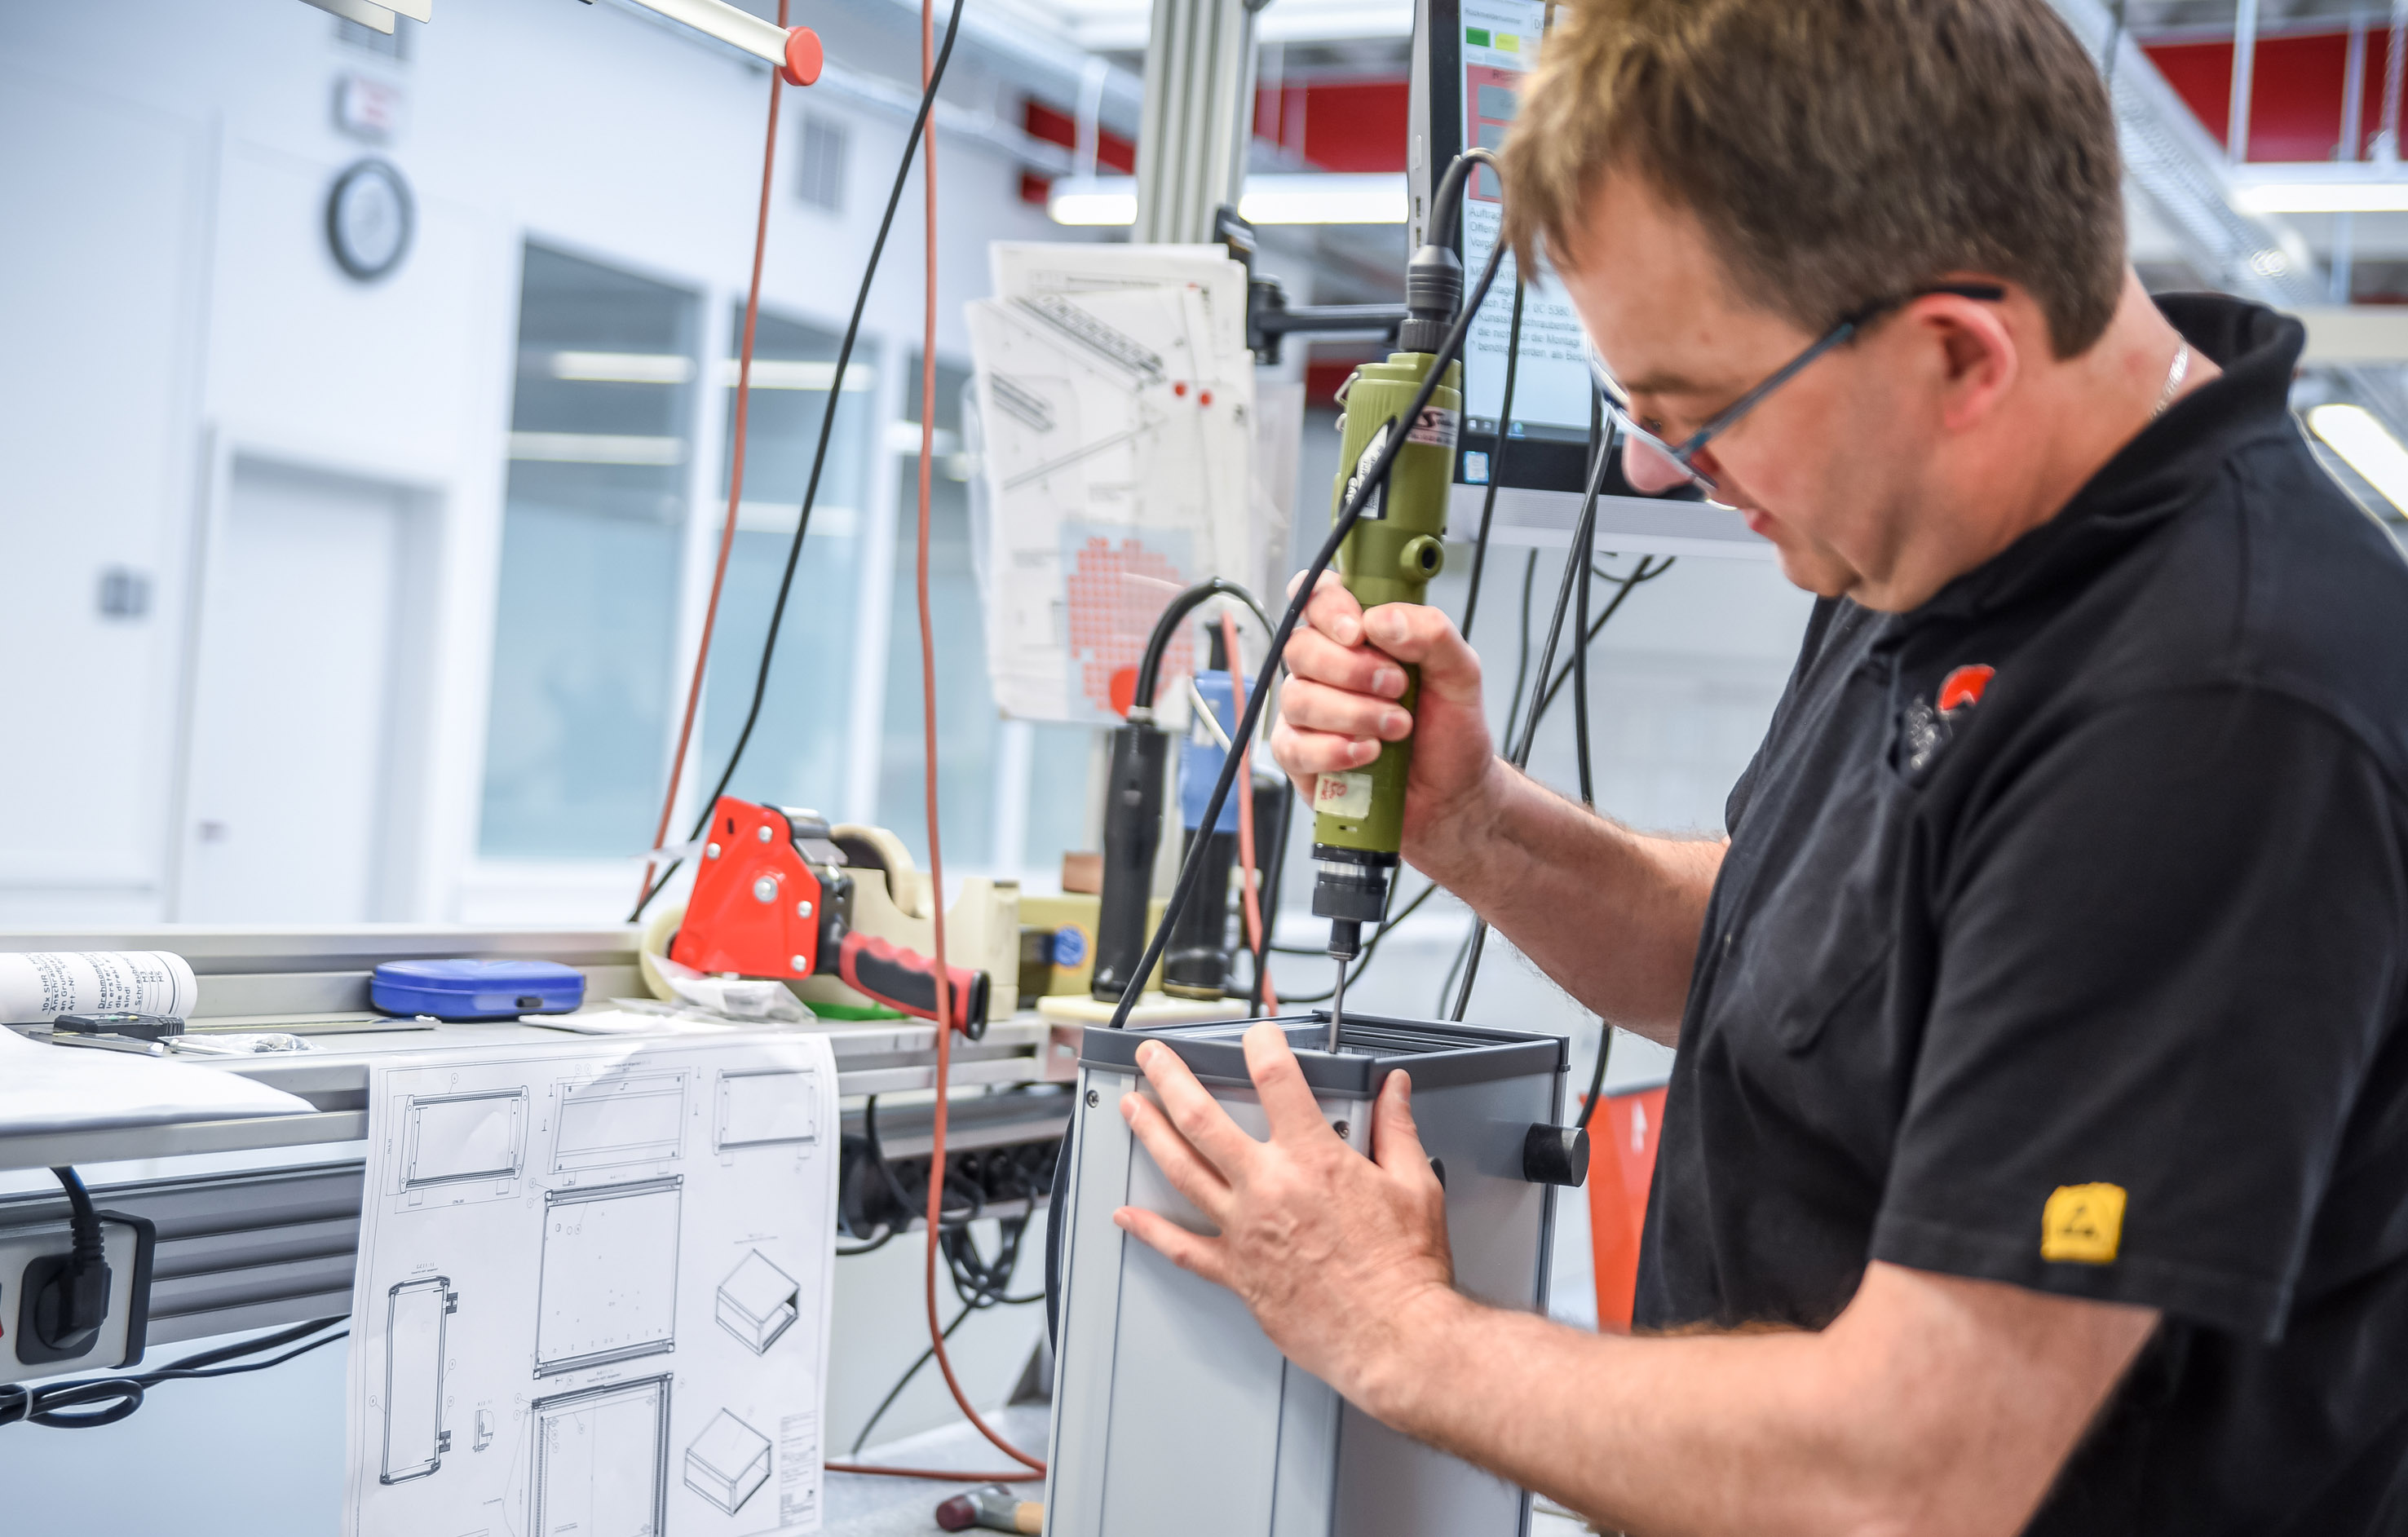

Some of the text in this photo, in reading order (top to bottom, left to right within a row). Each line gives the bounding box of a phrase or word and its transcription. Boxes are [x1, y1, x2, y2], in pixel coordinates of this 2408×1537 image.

[1470, 236, 1494, 250] Vorga
[41, 974, 51, 993] SHR
[104, 969, 114, 997] erster
[110, 966, 122, 992] direkt
[140, 971, 148, 983] M3
[157, 970, 164, 983] M5
[42, 996, 51, 1012] 10x
[60, 1000, 67, 1011] an
